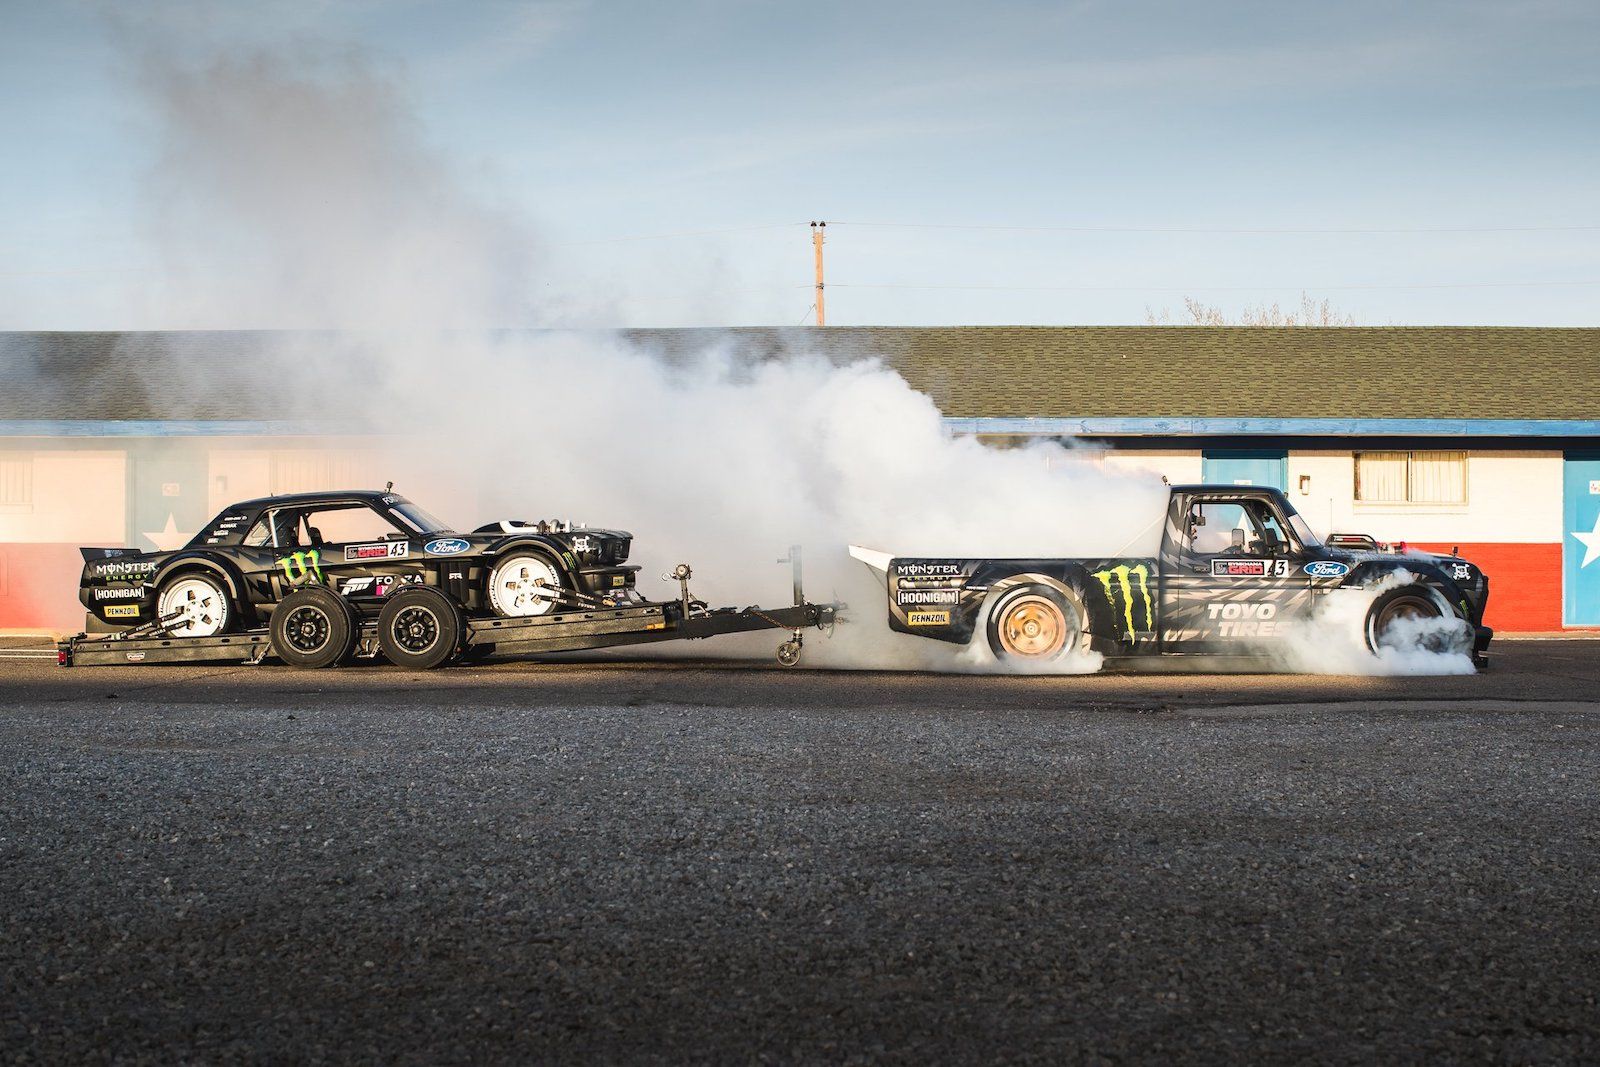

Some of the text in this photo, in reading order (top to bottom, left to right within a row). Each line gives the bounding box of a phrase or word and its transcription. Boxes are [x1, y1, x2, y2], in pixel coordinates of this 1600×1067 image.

[390, 542, 406, 557] 43
[433, 540, 462, 553] Ford
[96, 562, 157, 575] MONSTER
[898, 564, 959, 575] MONSTER
[1313, 563, 1341, 575] Ford
[376, 576, 423, 584] FOZA
[107, 606, 137, 616] PENNZOIL
[1207, 603, 1277, 620] TOYO
[911, 613, 946, 623] PENNZOIL
